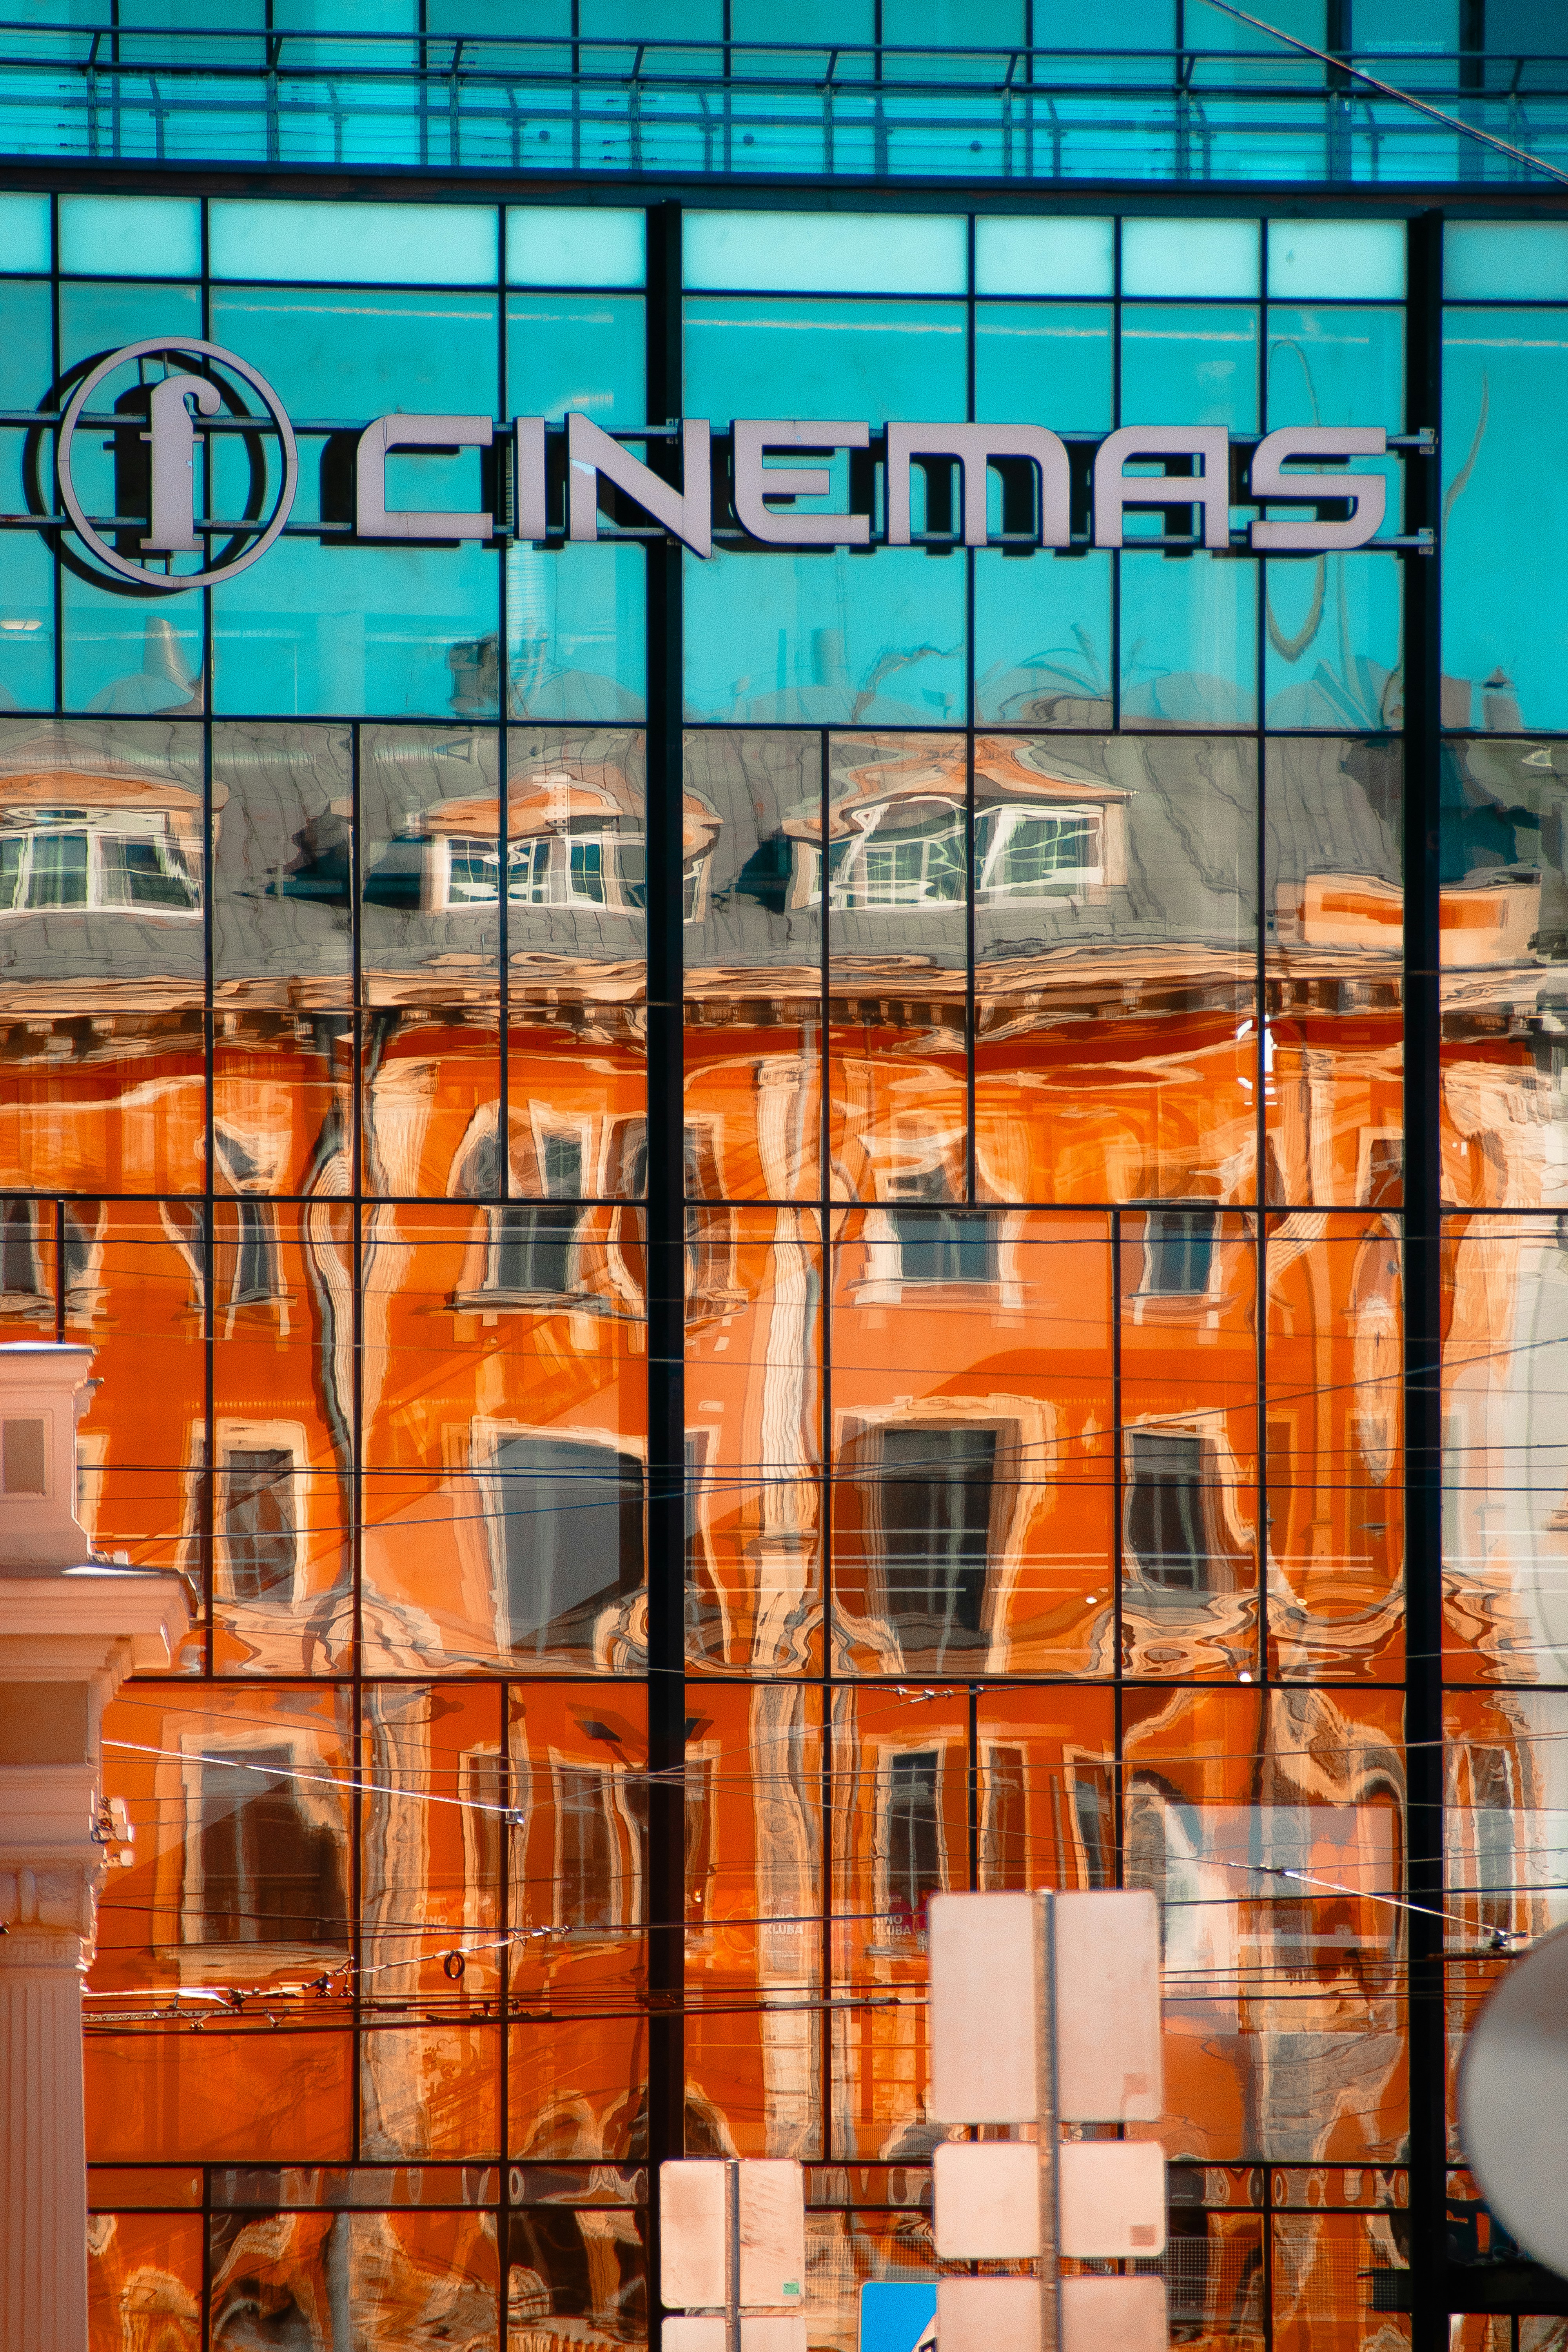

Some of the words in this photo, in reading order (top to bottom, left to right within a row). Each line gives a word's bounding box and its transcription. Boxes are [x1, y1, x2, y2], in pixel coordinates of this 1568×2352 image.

[356, 412, 1387, 560] CINEMAS
[764, 1924, 803, 1935] KLUBA
[872, 1925, 911, 1935] KLUBA
